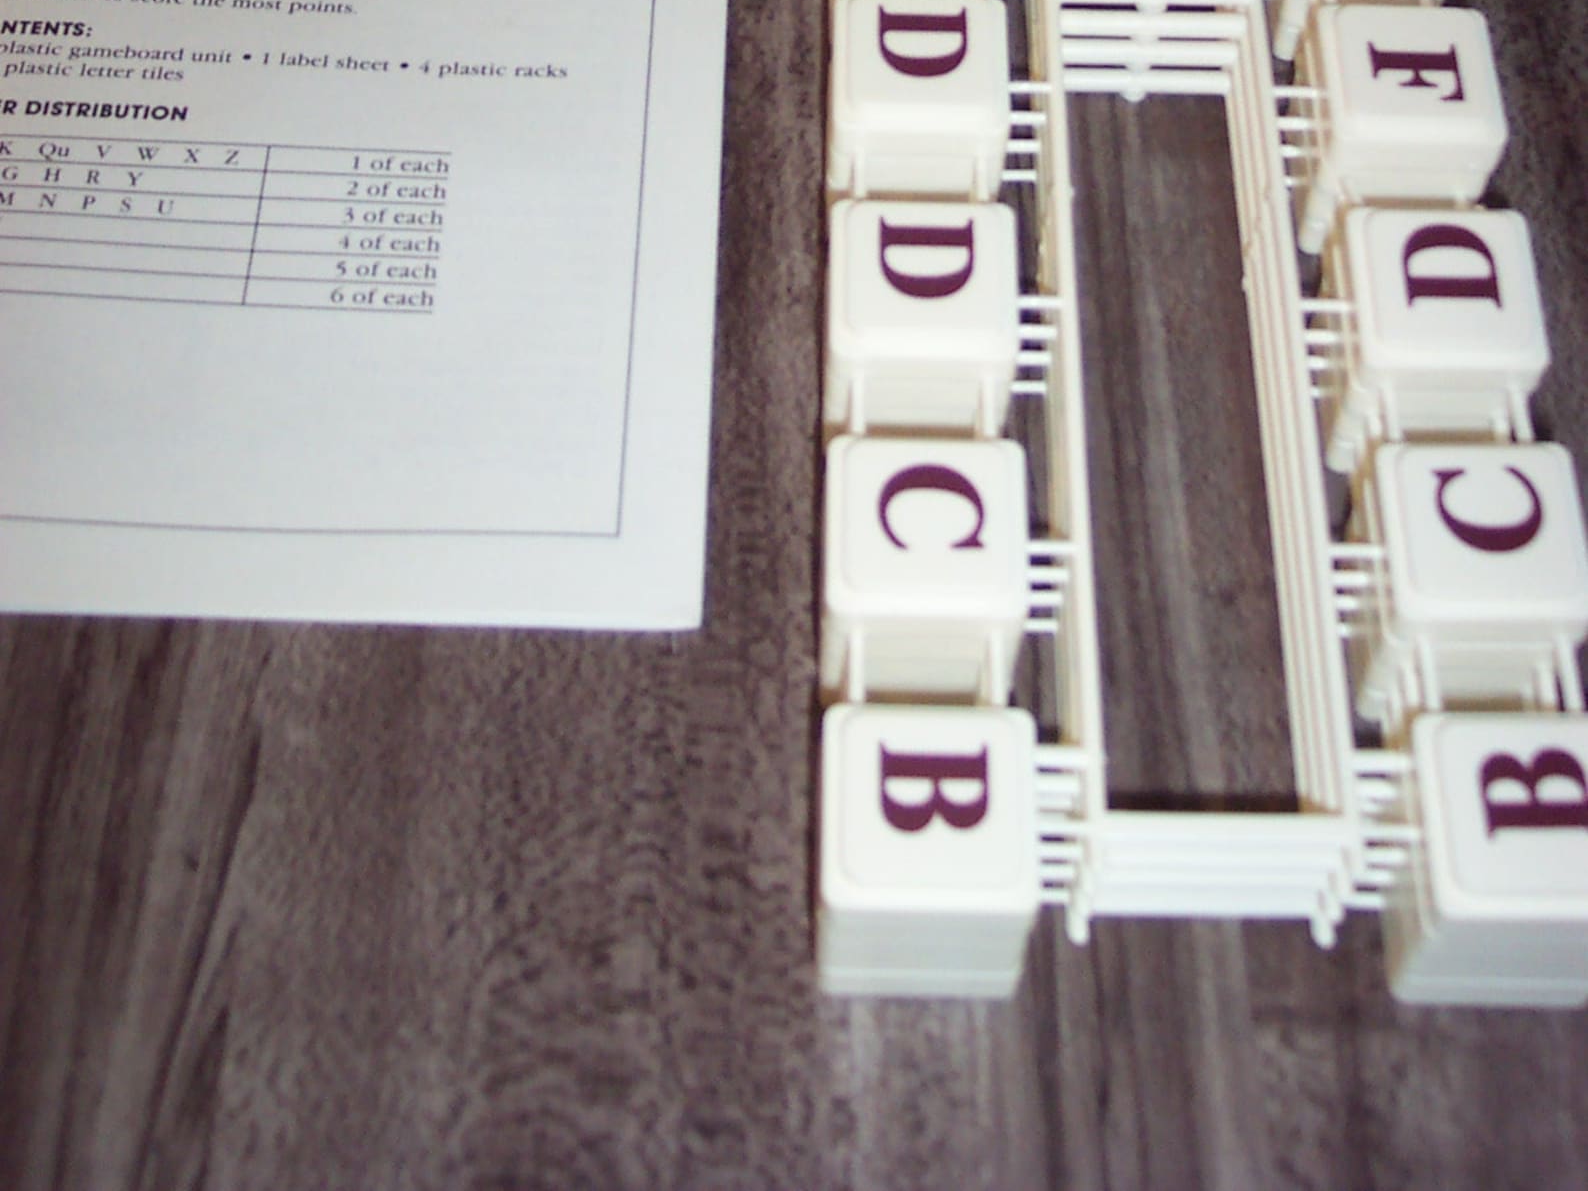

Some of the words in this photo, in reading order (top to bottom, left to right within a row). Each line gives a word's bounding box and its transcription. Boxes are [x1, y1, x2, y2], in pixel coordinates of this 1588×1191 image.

[288, 0, 356, 15] points.
[879, 7, 967, 77] D
[4, 59, 72, 77] plastic
[80, 62, 135, 79] letter
[142, 66, 184, 81] tiles
[68, 45, 184, 61] gameboard
[191, 49, 232, 63] unit
[280, 51, 328, 68] label
[336, 56, 389, 71] sheet
[439, 60, 506, 77] plastic
[515, 63, 568, 78] racks
[1369, 43, 1464, 101] F
[25, 101, 188, 121] DISTRIBUTION
[39, 142, 70, 160] Qu
[371, 157, 394, 171] of
[401, 159, 448, 173] each
[368, 182, 391, 197] of
[397, 184, 446, 199] each
[363, 209, 387, 223] of
[394, 211, 443, 225] each
[360, 235, 383, 250] of
[390, 237, 440, 252] each
[880, 219, 974, 299] D
[1403, 225, 1501, 307] D
[356, 262, 380, 277] of
[387, 263, 436, 279] each
[352, 289, 377, 304] of
[384, 291, 433, 306] each
[879, 465, 984, 548] C
[1435, 468, 1542, 552] C
[880, 747, 988, 832] B
[1480, 749, 1588, 833] B
